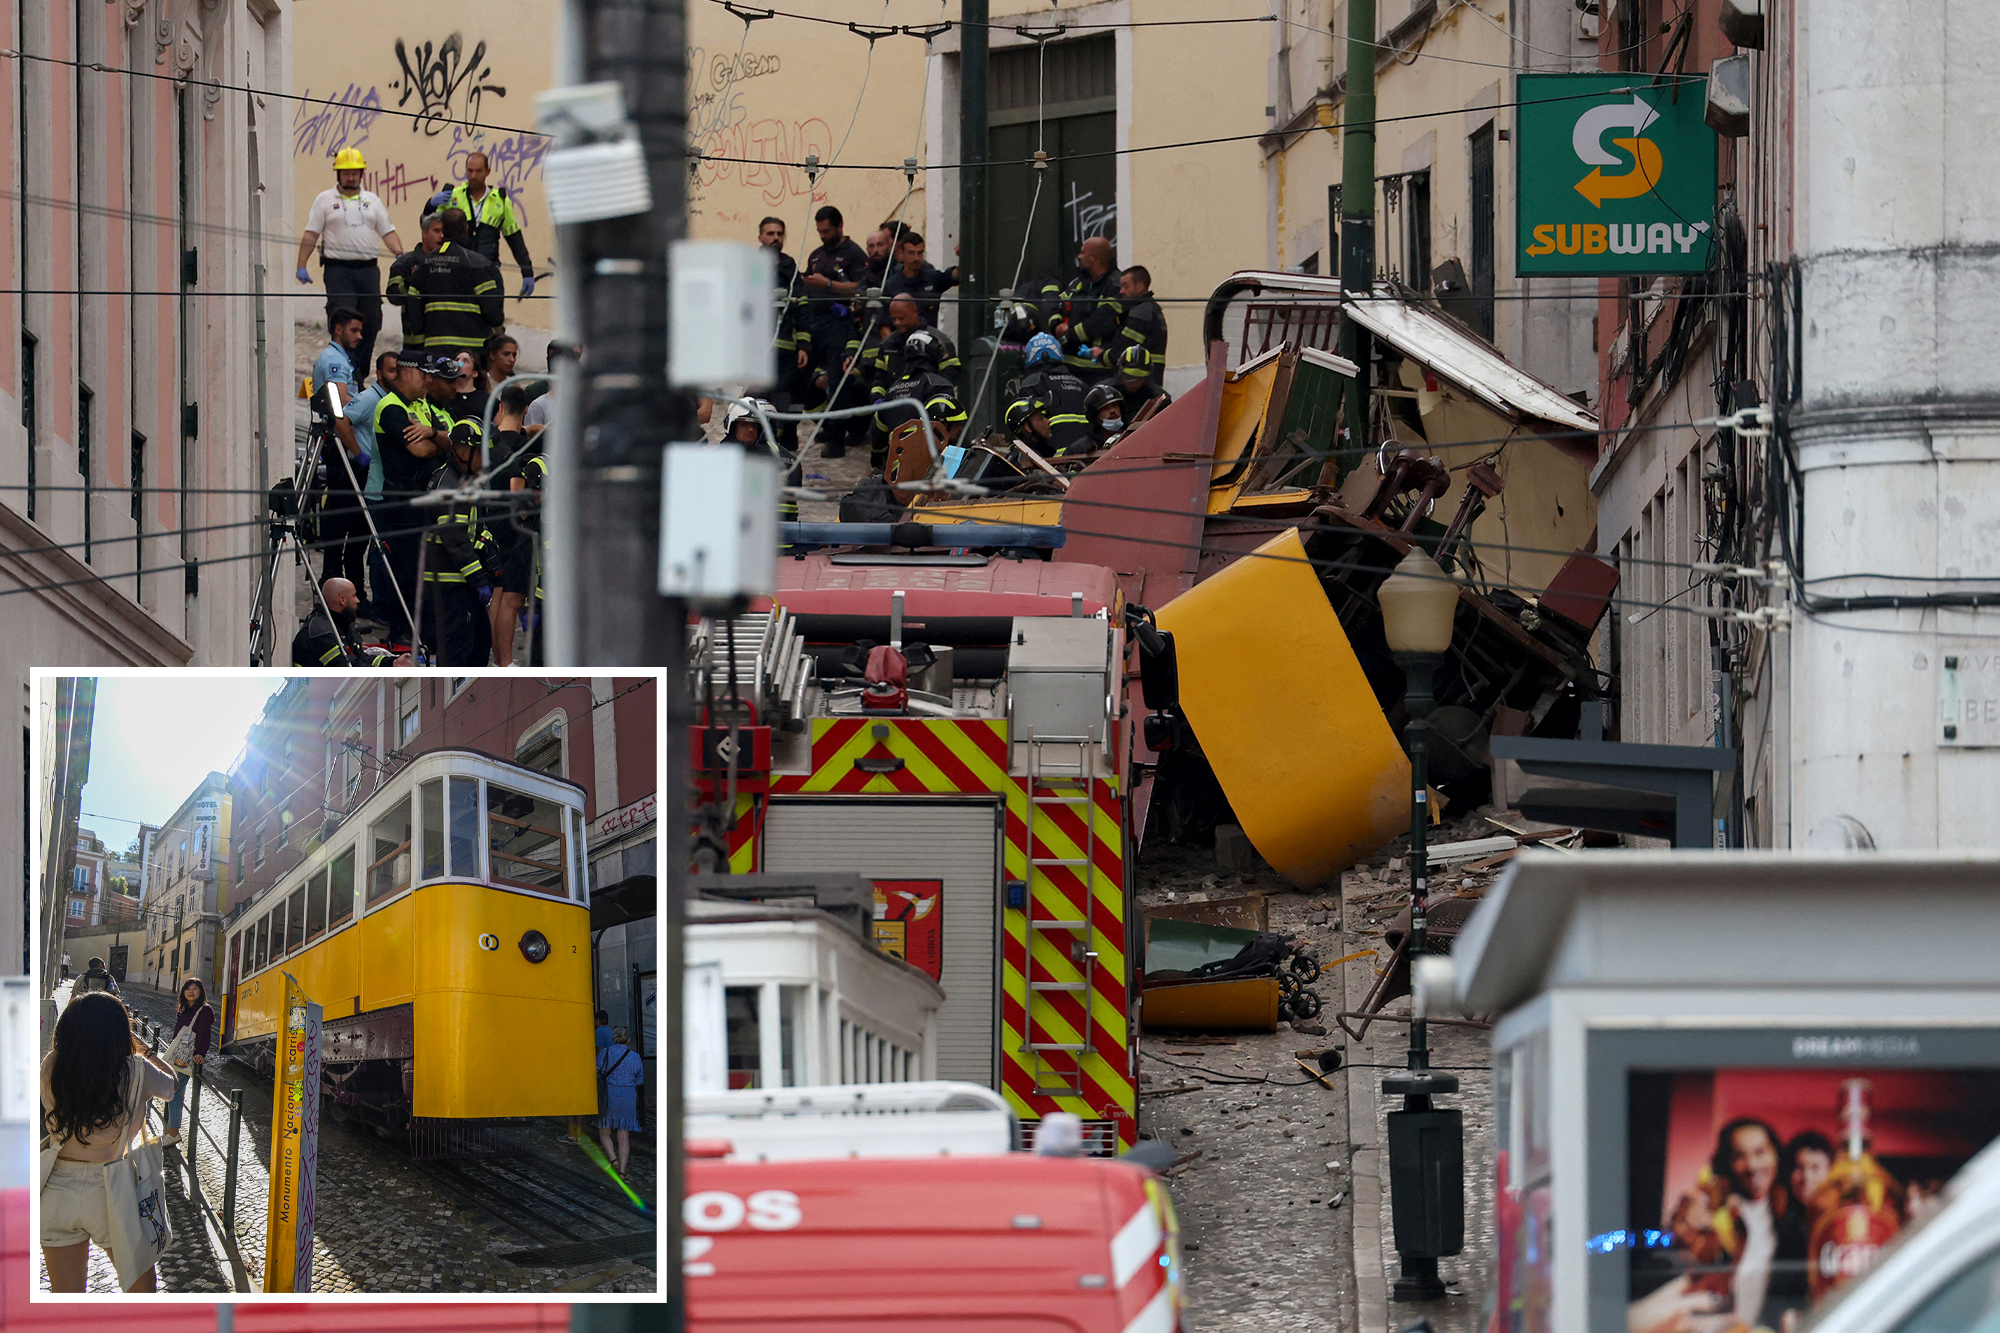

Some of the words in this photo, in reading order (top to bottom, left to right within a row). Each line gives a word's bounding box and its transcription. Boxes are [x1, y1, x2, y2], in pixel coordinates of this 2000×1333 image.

[1525, 219, 1711, 258] SUBWAY
[196, 800, 218, 809] HOTEL
[572, 945, 577, 954] 2
[927, 928, 936, 964] LISBOA
[283, 1080, 296, 1140] Nacional
[279, 1147, 293, 1224] Monumento
